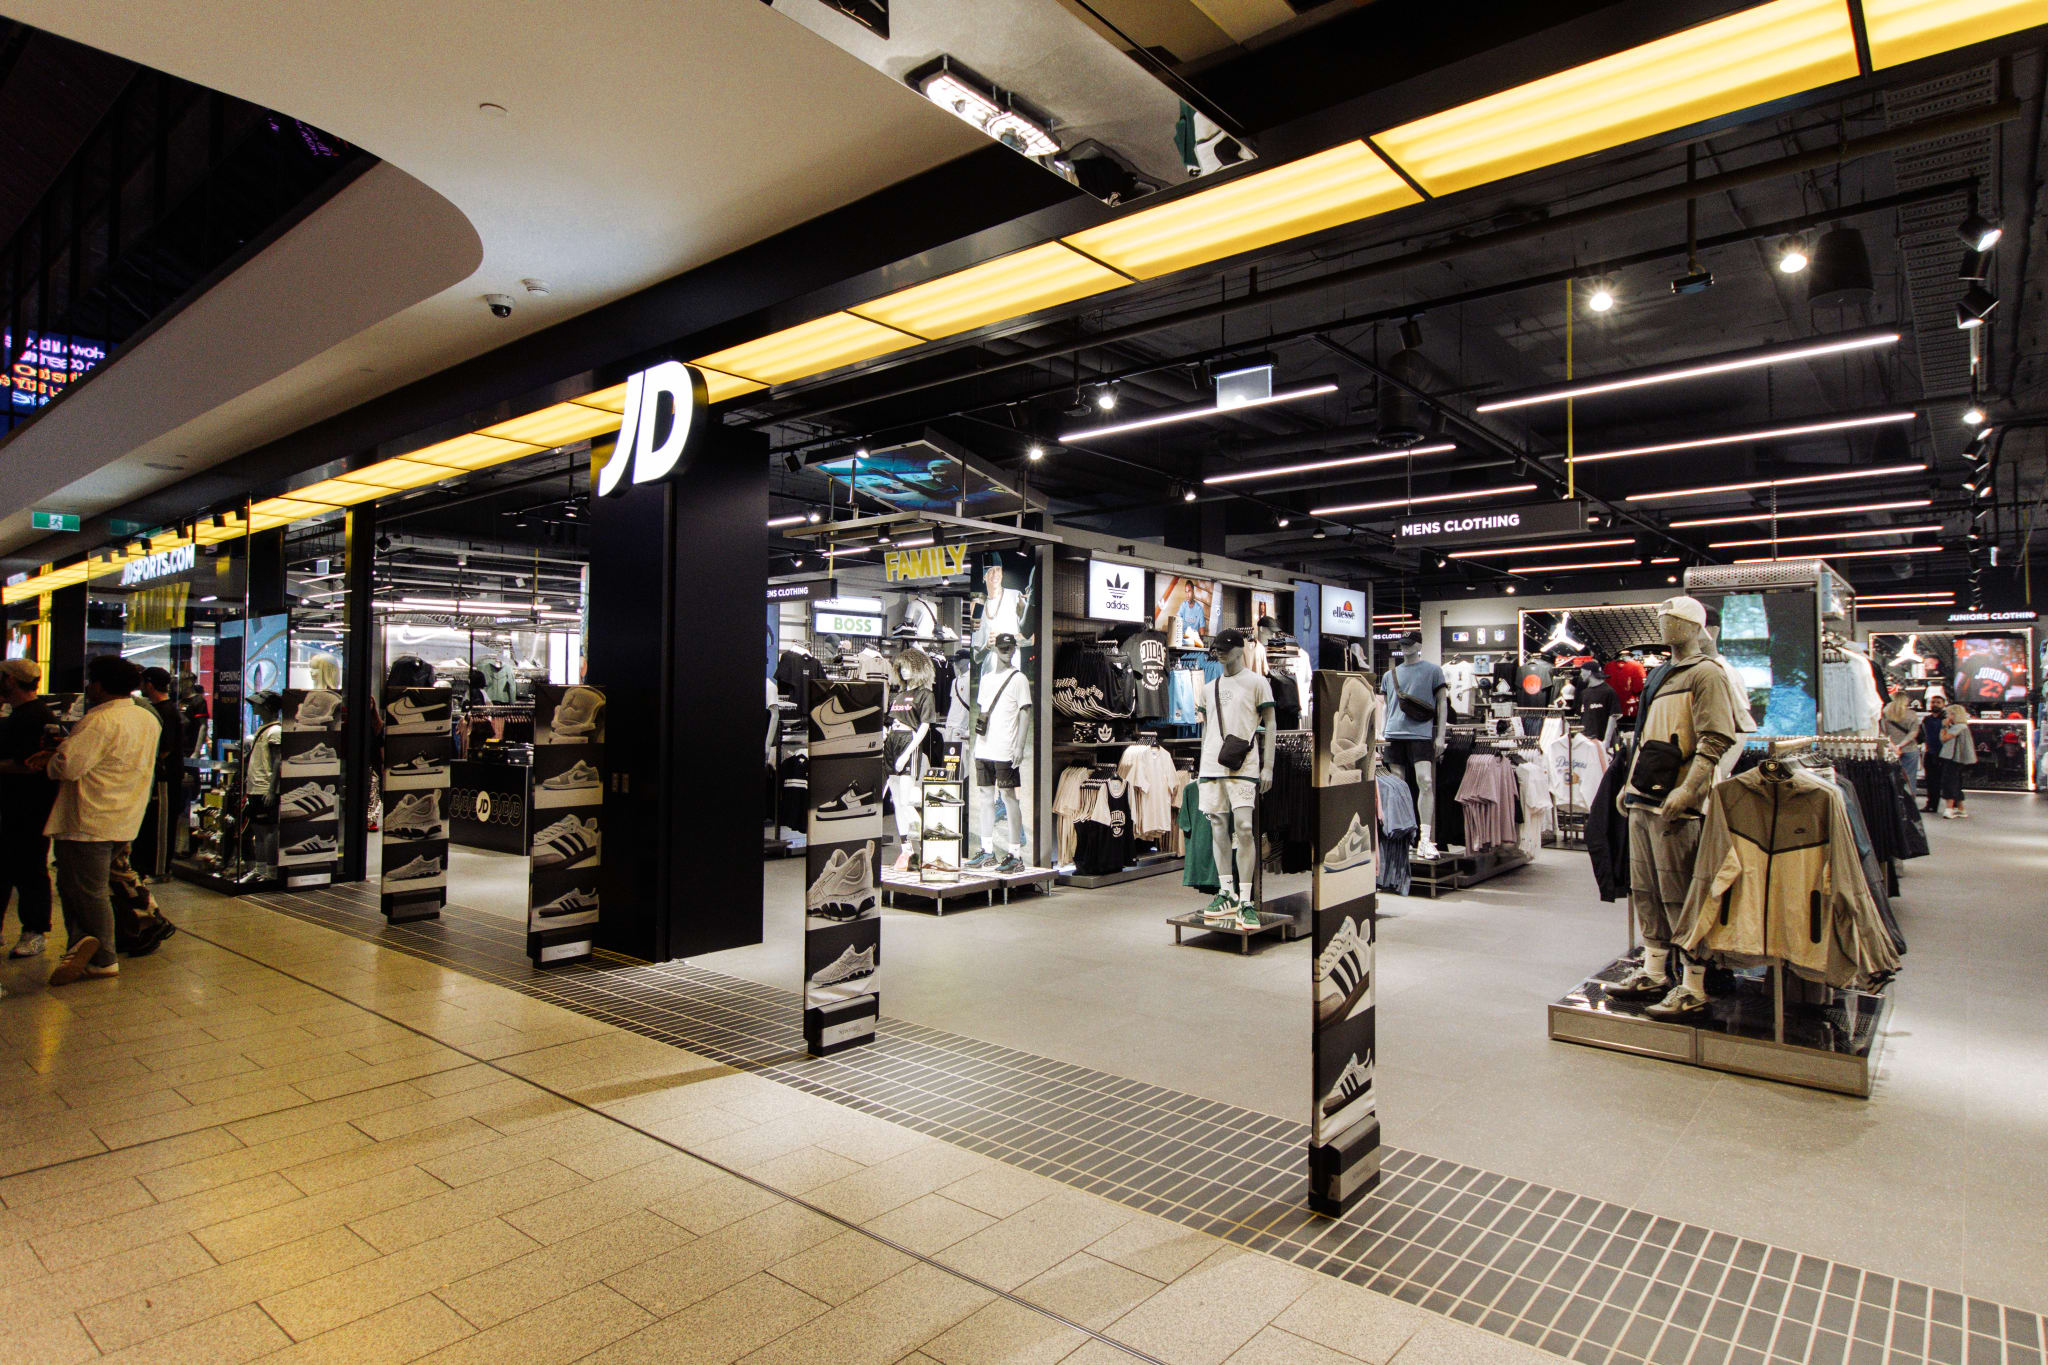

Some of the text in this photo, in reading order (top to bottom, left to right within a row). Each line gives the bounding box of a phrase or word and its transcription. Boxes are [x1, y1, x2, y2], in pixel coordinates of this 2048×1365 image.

[598, 360, 694, 497] JD
[1401, 514, 1520, 536] MENS CLOTHING
[120, 544, 195, 586] JDSPORTS.COM
[884, 543, 968, 582] FAMILY
[778, 587, 809, 597] CLOTHING
[1105, 601, 1130, 611] adidas
[1332, 606, 1356, 620] ellesse
[834, 616, 872, 633] BOSS
[1947, 613, 1990, 622] JUNIORS
[1979, 679, 2004, 698] 23
[478, 798, 489, 814] JD
